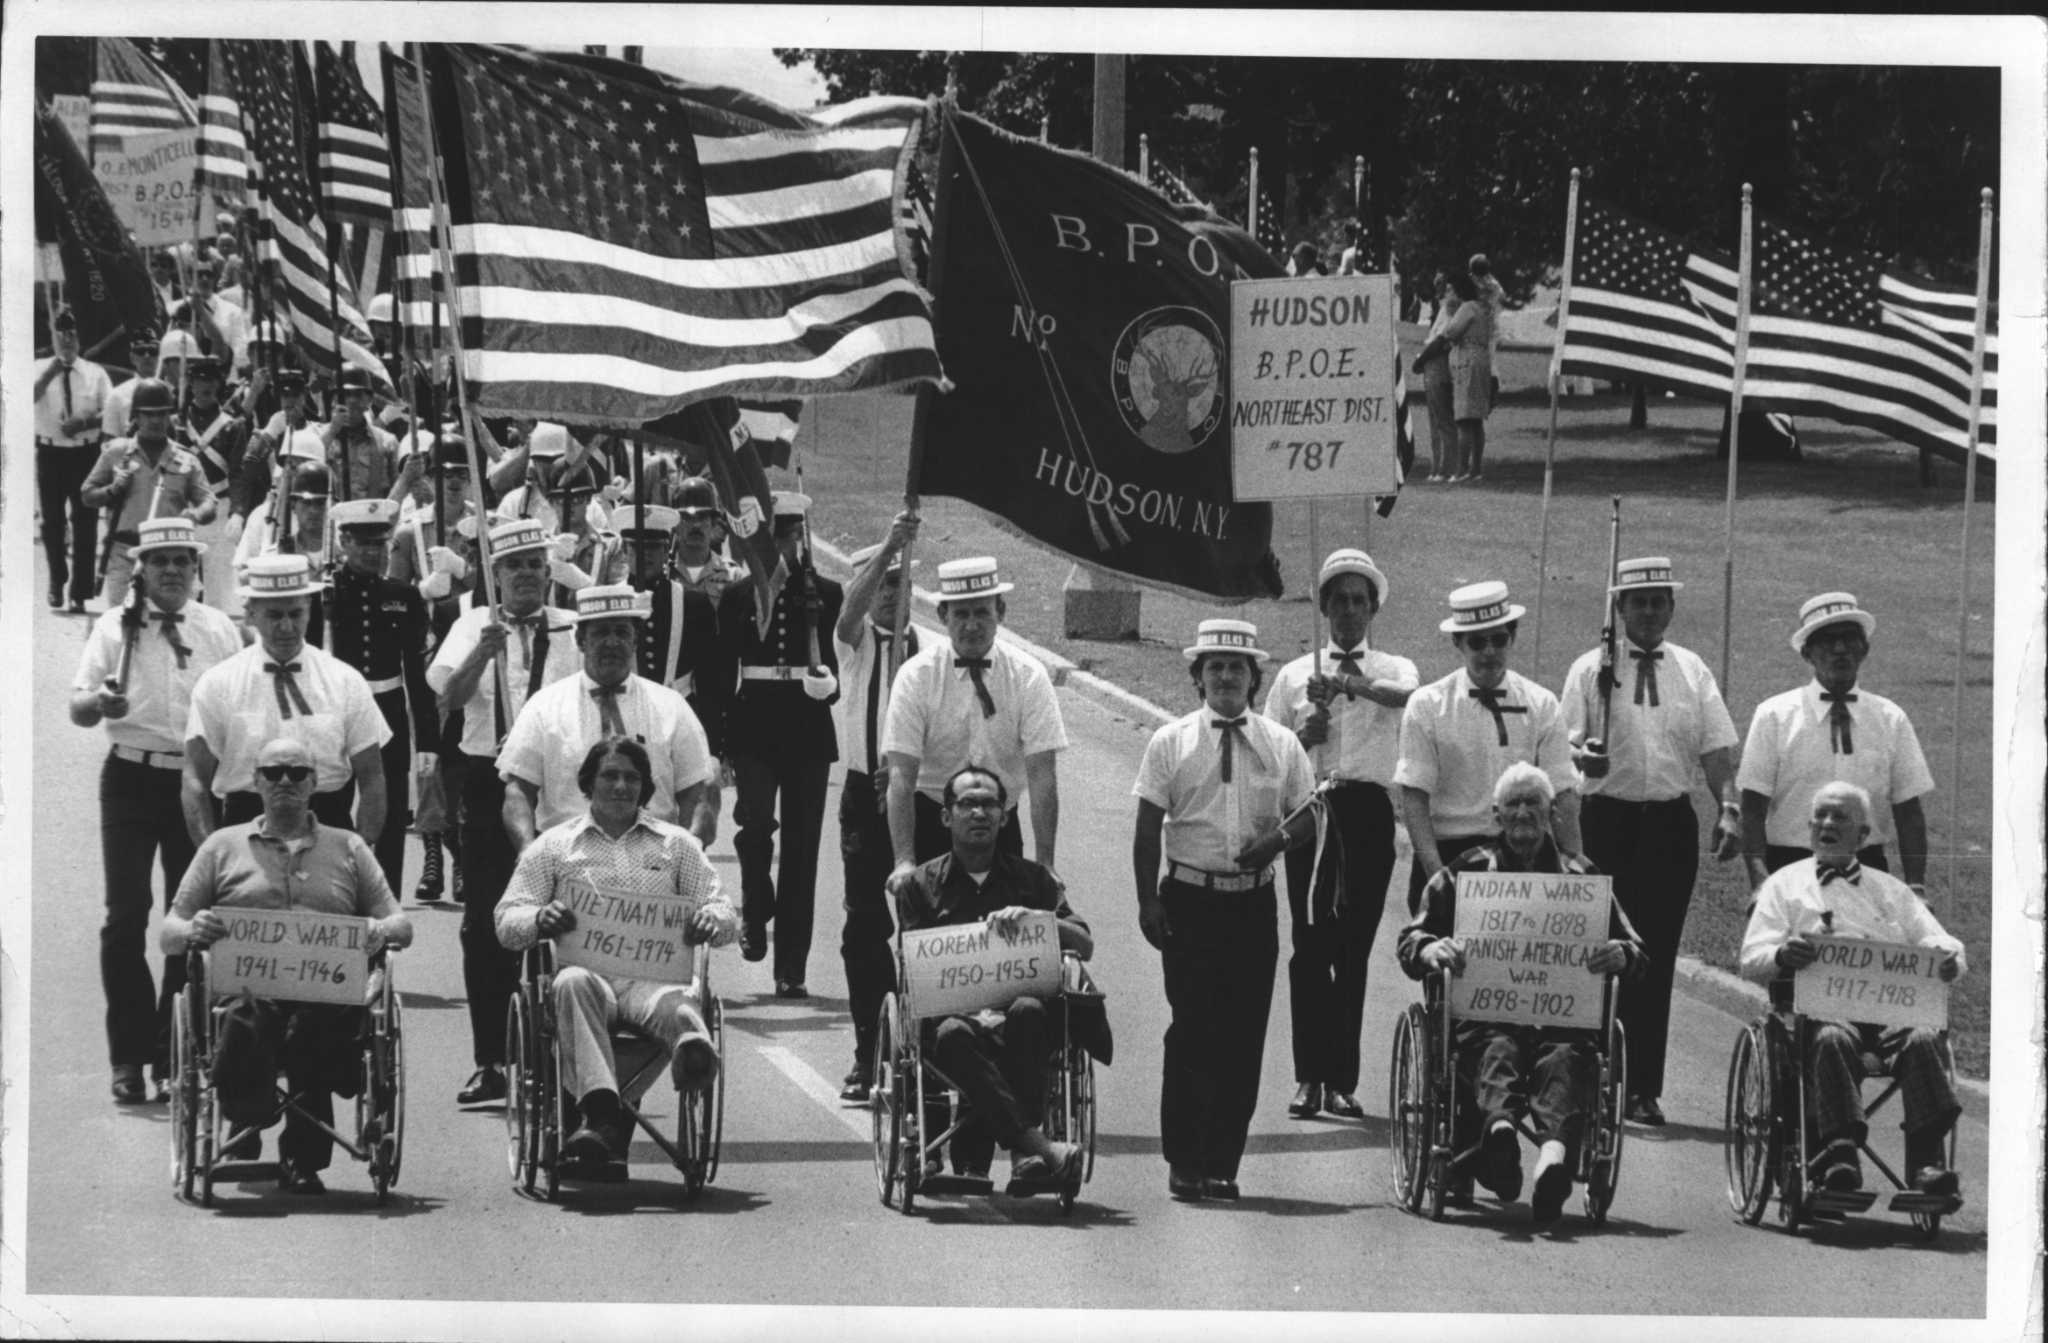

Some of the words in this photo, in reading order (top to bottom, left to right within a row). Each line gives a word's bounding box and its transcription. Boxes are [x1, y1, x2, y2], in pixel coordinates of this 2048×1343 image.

[126, 140, 195, 176] MONTICELL
[1051, 213, 1253, 281] B.P.O.
[1249, 293, 1371, 328] HUDSON
[1253, 348, 1366, 380] B.P.O.E.
[1232, 397, 1338, 428] NORTHEAST
[1343, 396, 1388, 424] DIST.
[570, 887, 659, 927] VIETNAM
[1465, 880, 1532, 899] INDIAN
[1543, 882, 1596, 902] WARS
[296, 922, 340, 947] WAR
[1480, 910, 1521, 932] 1817
[1542, 912, 1587, 937] 1898
[583, 929, 676, 964] 1961-1974
[916, 931, 990, 959] KOREAN
[1002, 924, 1047, 949] WAR
[235, 955, 347, 984] 1941-1946
[939, 956, 1040, 990] 1950-1955
[1509, 967, 1549, 986] WAR
[1882, 951, 1918, 975] WAR
[1469, 987, 1576, 1017] 1898-1902
